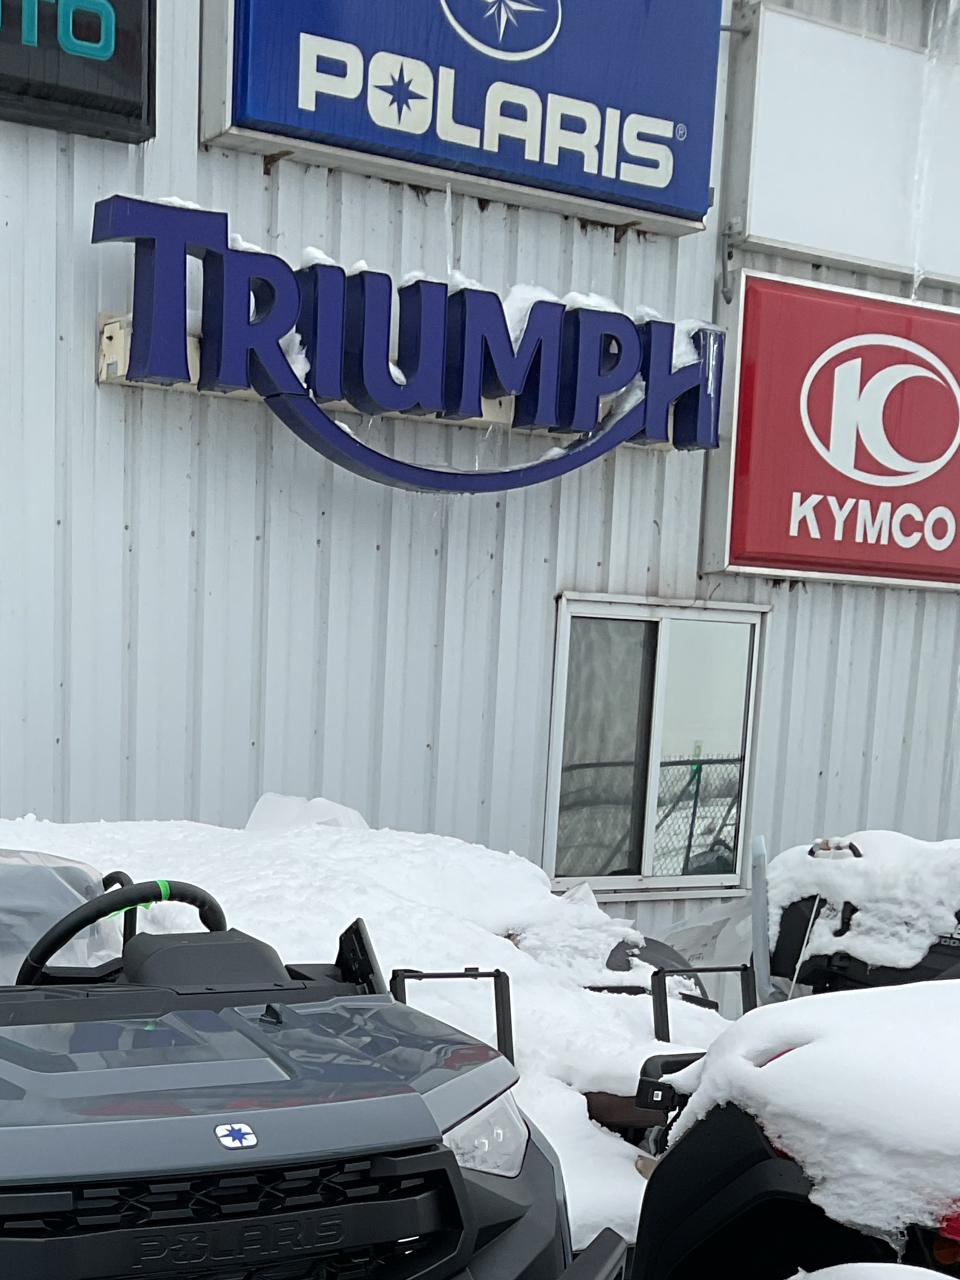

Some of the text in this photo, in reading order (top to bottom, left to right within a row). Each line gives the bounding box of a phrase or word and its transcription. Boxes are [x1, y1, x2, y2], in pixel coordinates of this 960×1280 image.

[297, 32, 675, 189] POLARIS
[92, 194, 727, 494] TRIUMPH
[789, 491, 957, 551] KYMCO
[132, 1213, 346, 1268] POLARIS
